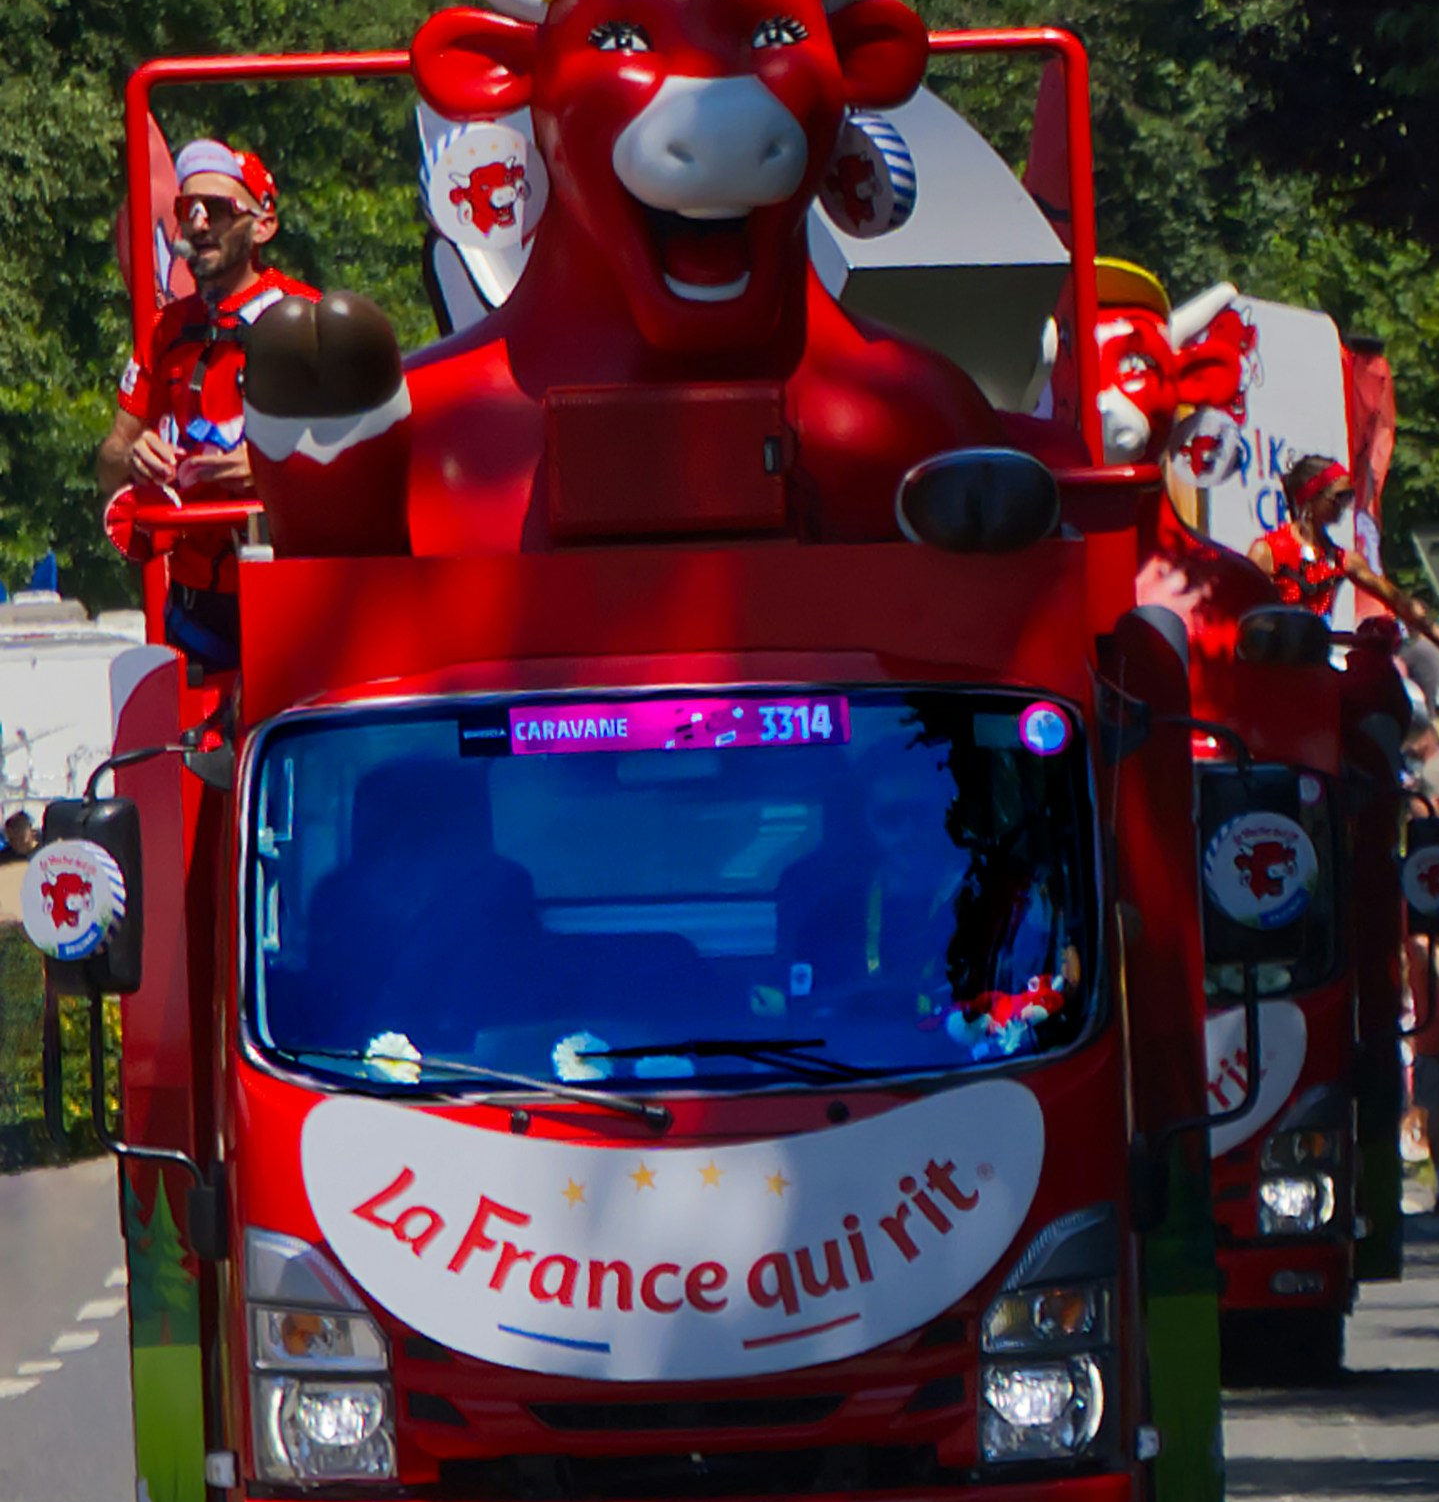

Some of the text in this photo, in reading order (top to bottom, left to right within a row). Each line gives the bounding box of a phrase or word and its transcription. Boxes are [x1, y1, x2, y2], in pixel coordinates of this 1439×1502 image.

[515, 718, 628, 742] CARAVANE
[758, 704, 833, 742] 3314
[352, 1157, 981, 1316] La France qui rit
